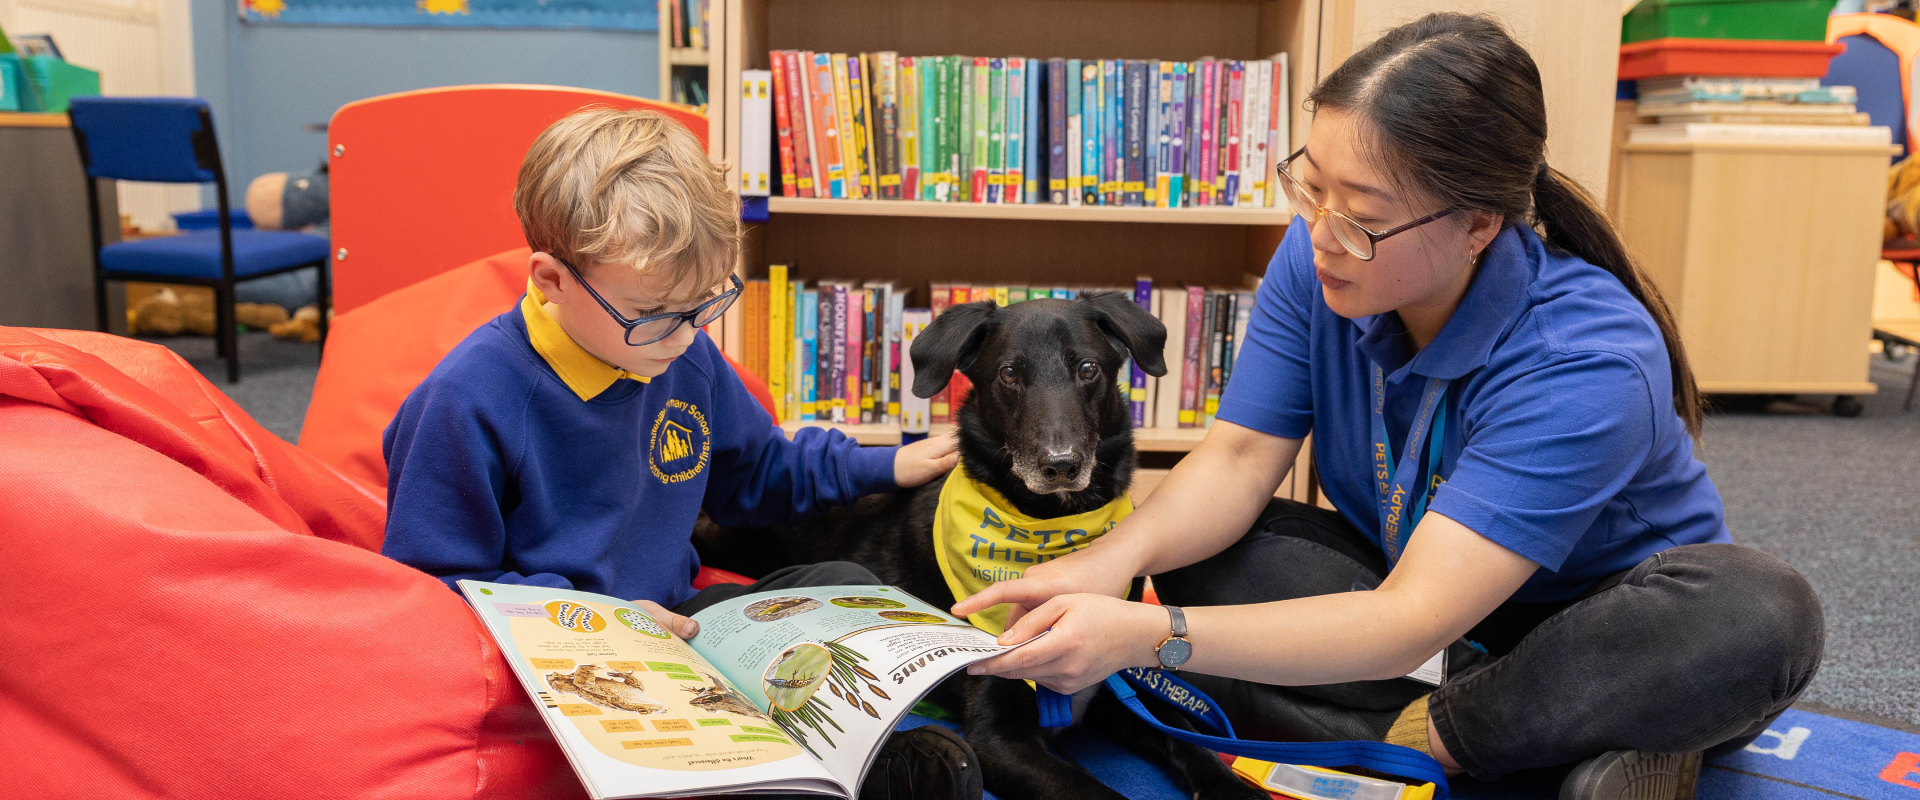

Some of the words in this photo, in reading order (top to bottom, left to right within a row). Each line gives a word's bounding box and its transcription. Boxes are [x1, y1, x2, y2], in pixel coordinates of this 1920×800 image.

[688, 404, 711, 437] School
[669, 460, 706, 483] children
[1375, 442, 1389, 480] PETS
[979, 507, 1088, 550] PETS
[1385, 483, 1406, 545] THERAPY
[970, 565, 1025, 583] visitin
[892, 646, 1007, 685] MPHIBIANS
[1143, 670, 1162, 690] AS
[1159, 678, 1212, 717] THERAPY
[1314, 776, 1346, 788] PETS
